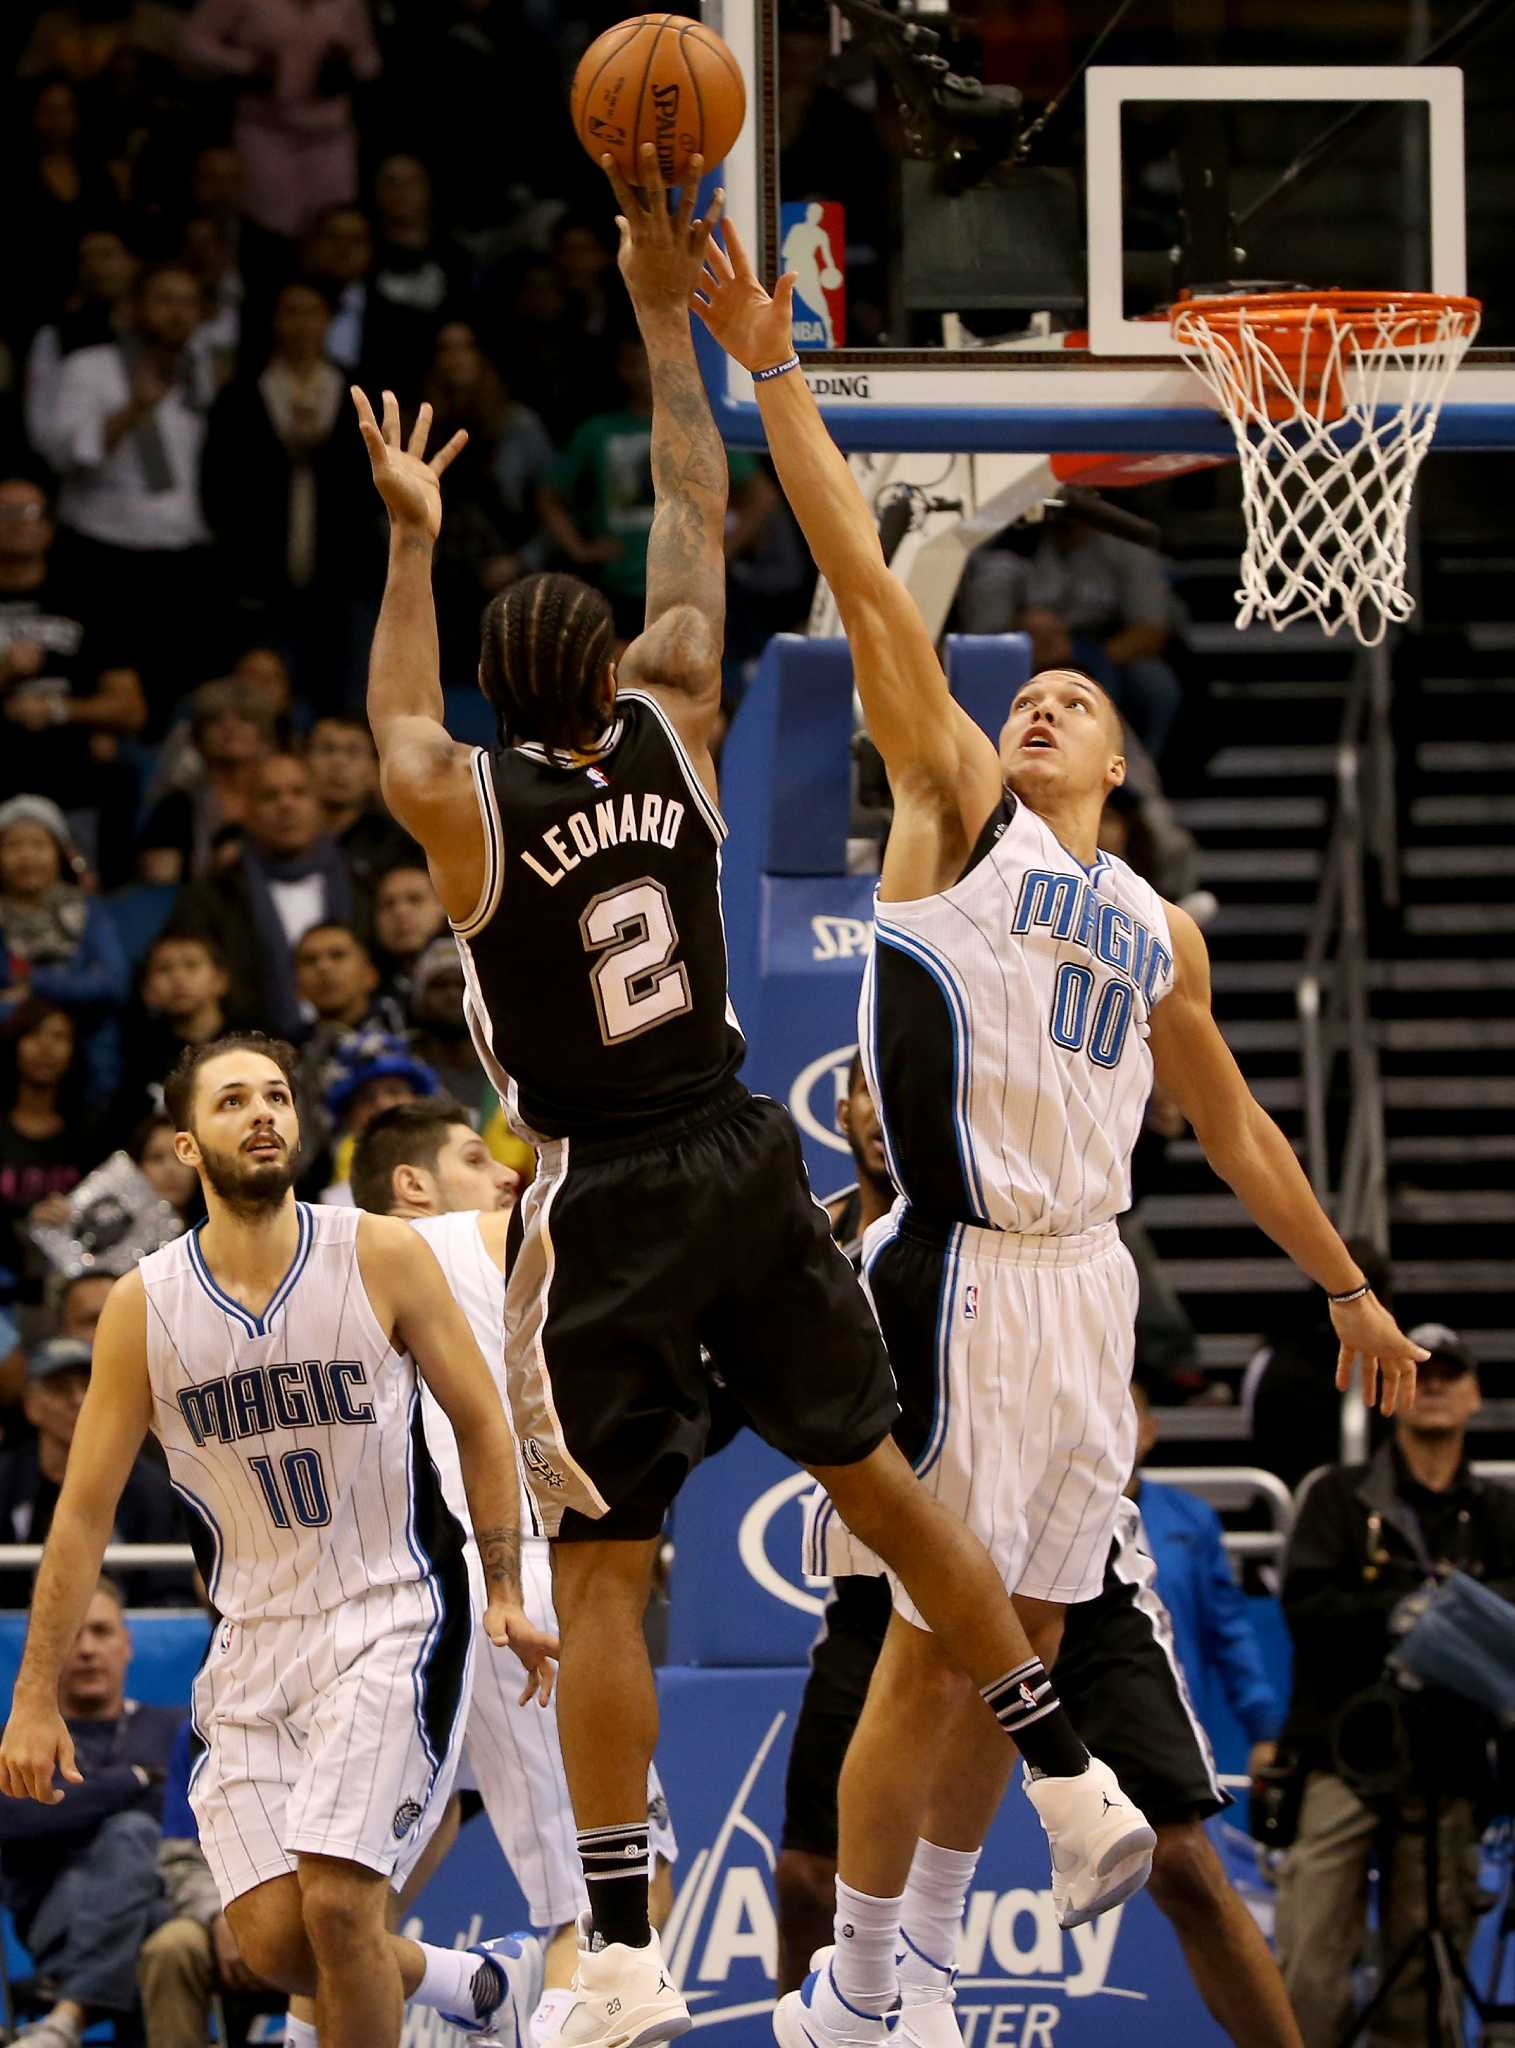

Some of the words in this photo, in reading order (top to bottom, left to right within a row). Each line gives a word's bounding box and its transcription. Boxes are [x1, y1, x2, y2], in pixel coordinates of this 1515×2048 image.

[520, 793, 685, 887] LEONARD
[577, 875, 693, 1046] 2
[1010, 869, 1174, 1015] MAGIC
[1050, 961, 1134, 1069] 00
[176, 1359, 377, 1447] MAGIC
[247, 1447, 332, 1528] 10
[606, 1997, 622, 2016] 23
